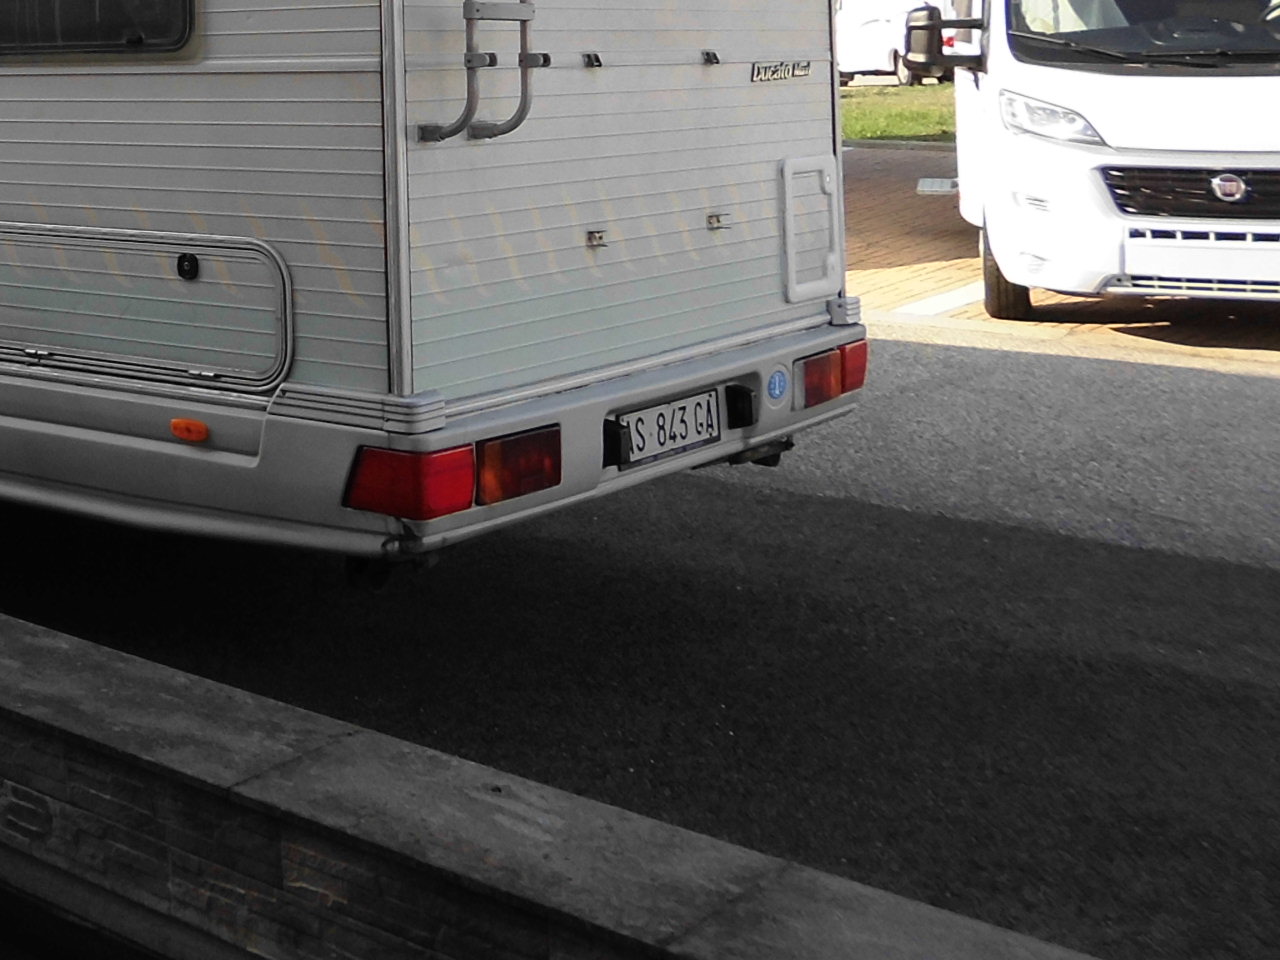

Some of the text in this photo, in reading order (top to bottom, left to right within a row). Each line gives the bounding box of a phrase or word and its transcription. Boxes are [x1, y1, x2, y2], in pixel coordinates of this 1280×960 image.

[629, 399, 715, 454] S 843 GA
